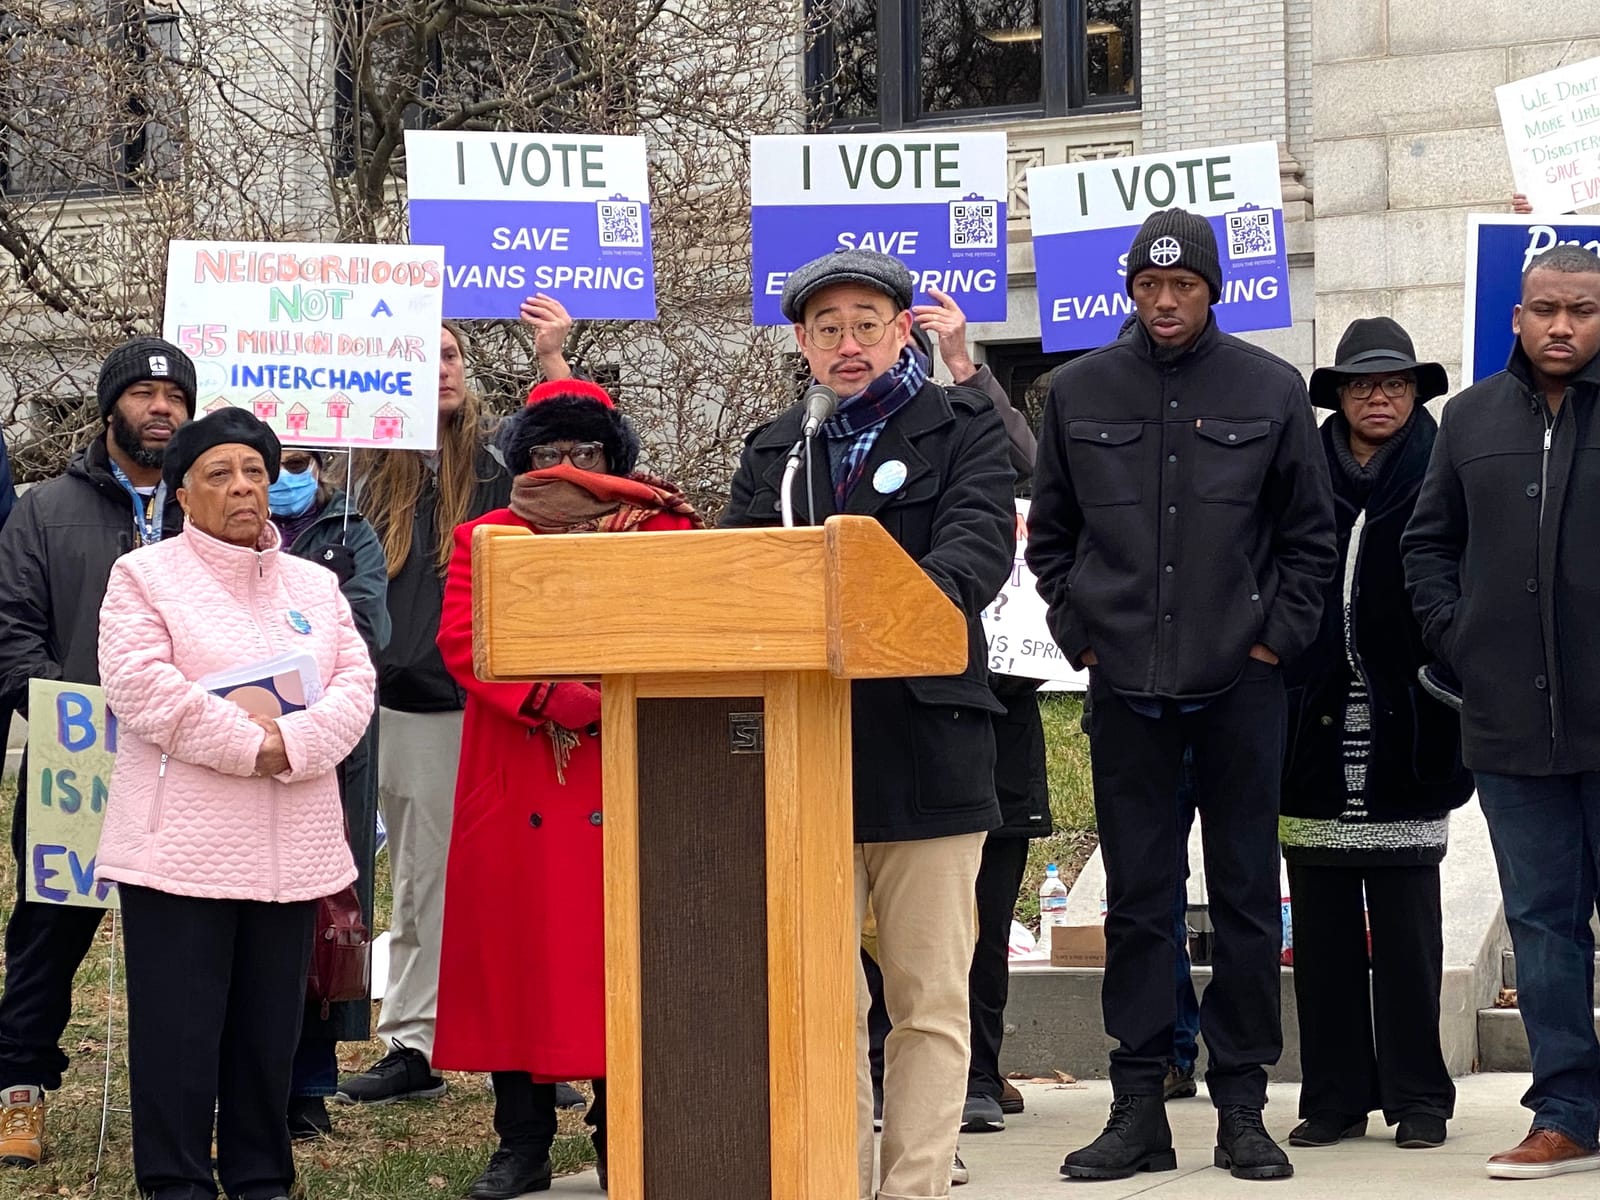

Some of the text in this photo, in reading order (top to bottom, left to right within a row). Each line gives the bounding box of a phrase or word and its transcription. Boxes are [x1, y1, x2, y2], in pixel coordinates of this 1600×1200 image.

[1525, 115, 1566, 139] MORE
[456, 141, 606, 188] I VOTE
[803, 143, 961, 190] I VOTE
[1546, 159, 1582, 184] SAVE
[1077, 155, 1235, 216] I VOTE
[491, 227, 570, 251] SAVE
[836, 231, 919, 255] SAVE
[194, 248, 440, 288] NEIGBORHOODS
[444, 265, 644, 290] VANS SPRING
[269, 284, 393, 322] NOT A
[1052, 276, 1278, 322] EVAN ING
[177, 324, 427, 362] 55 MILLION DOLLAR
[231, 364, 413, 396] INTERCHANGE
